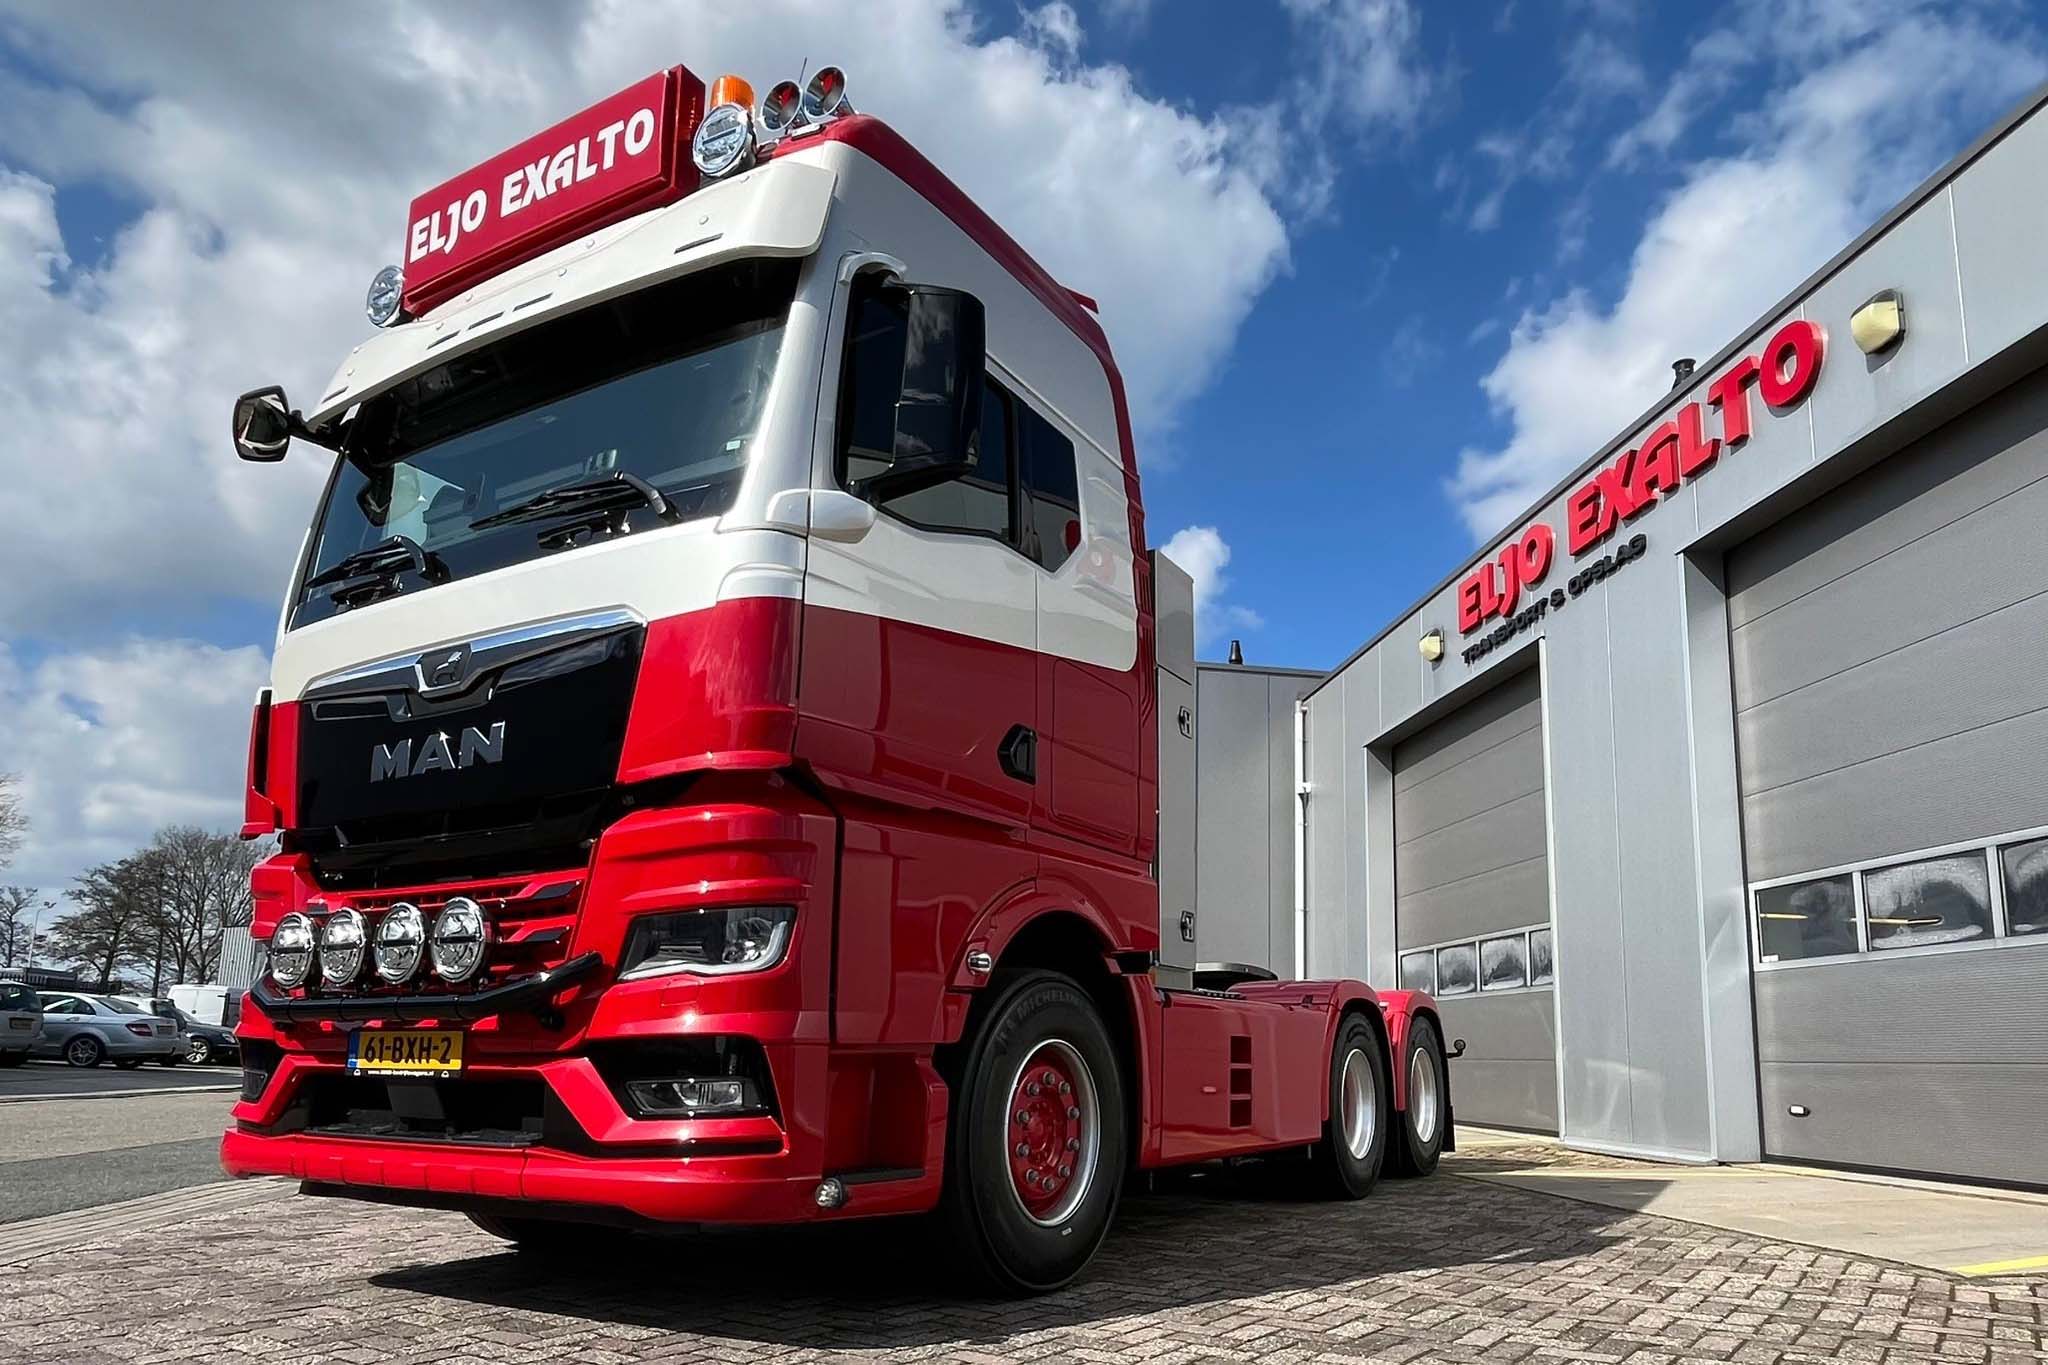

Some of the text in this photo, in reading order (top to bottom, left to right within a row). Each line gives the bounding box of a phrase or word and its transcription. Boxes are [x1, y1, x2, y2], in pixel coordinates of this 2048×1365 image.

[409, 108, 655, 264] ELJO EXALTO
[1458, 320, 1825, 634] ELJO EXALTO
[1461, 533, 1648, 665] TRANSPORT & OPSLAG
[370, 720, 505, 783] MAN
[364, 1036, 452, 1065] 61-BXH-2
